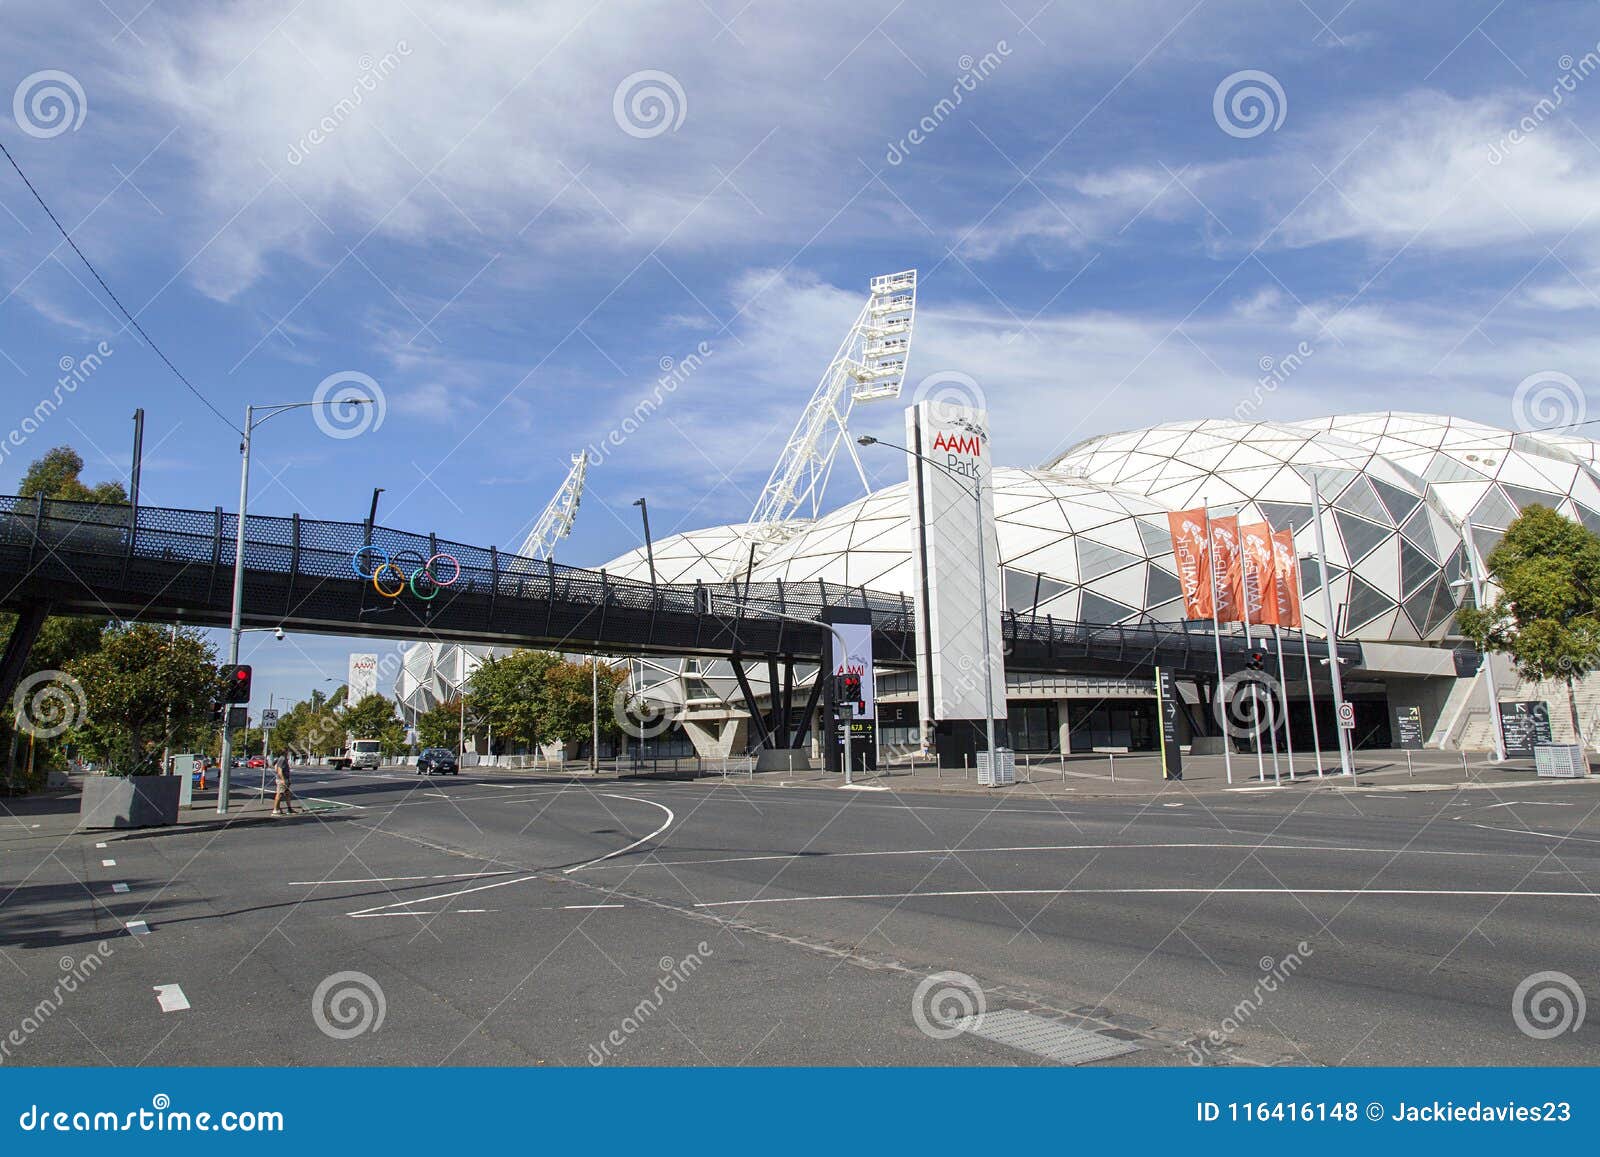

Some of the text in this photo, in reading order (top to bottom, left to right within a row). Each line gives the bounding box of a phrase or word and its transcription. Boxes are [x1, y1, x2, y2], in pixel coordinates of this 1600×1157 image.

[933, 431, 980, 457] AAMI
[947, 453, 981, 478] Park
[896, 709, 903, 720] E
[1342, 708, 1350, 716] 10
